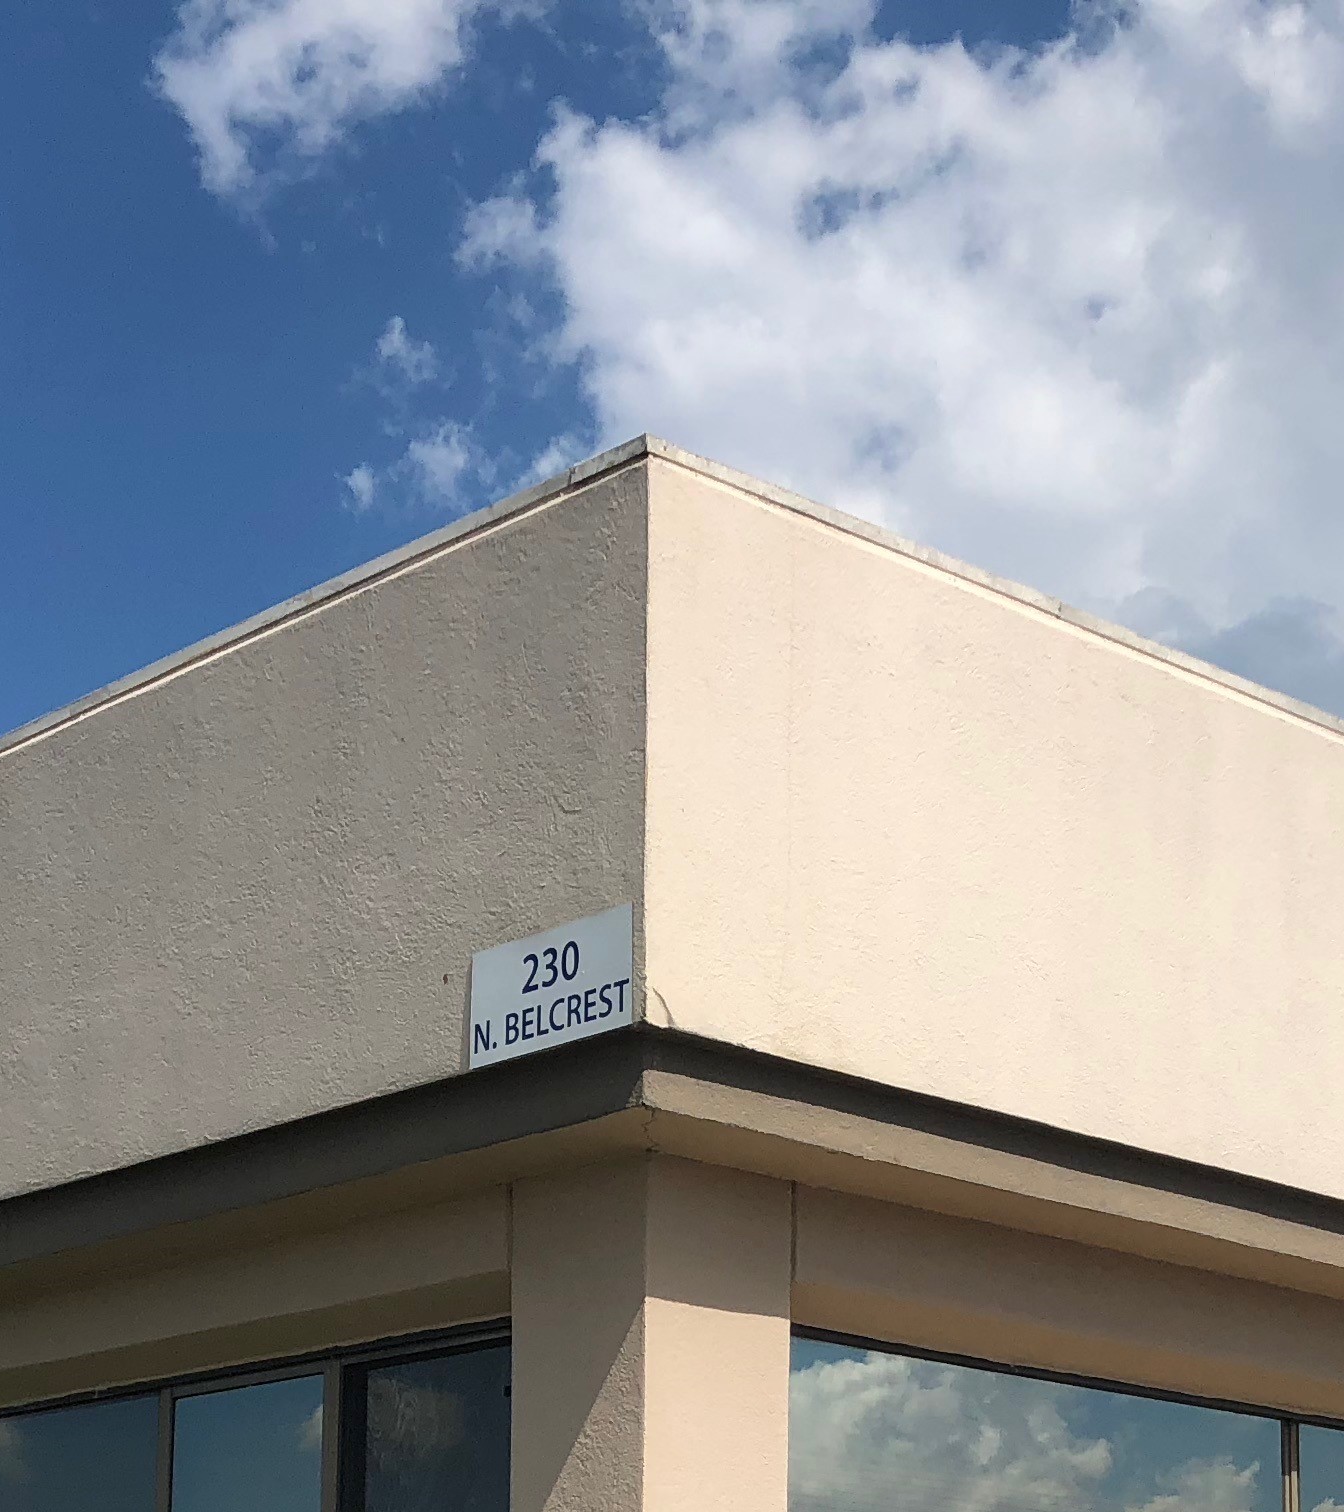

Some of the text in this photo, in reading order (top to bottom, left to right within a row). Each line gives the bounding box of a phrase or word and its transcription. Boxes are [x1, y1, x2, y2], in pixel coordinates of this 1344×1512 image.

[522, 941, 580, 994] 230
[474, 978, 630, 1054] N. BELCREST
